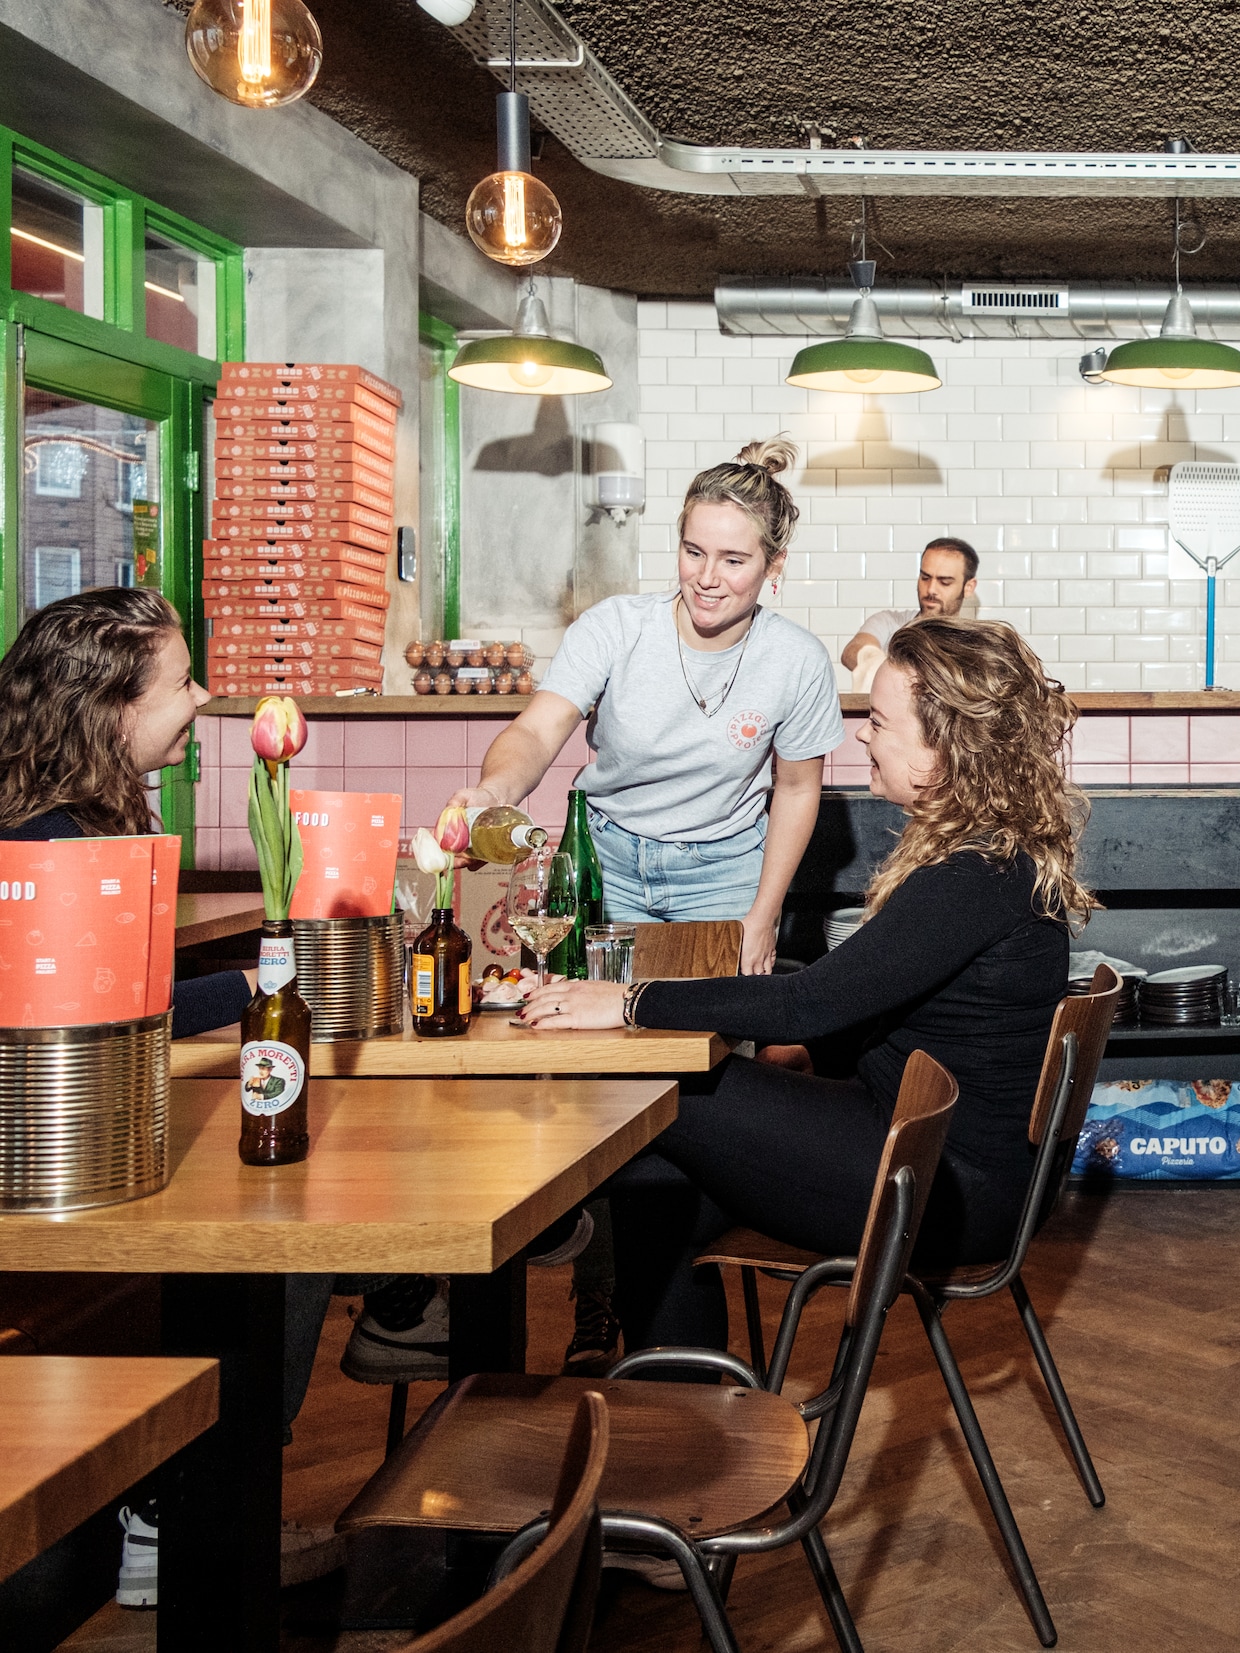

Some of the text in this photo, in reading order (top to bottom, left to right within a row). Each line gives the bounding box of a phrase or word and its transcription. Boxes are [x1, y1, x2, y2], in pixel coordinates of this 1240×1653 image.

[295, 811, 329, 827] FOOD
[0, 881, 36, 900] OOD
[260, 957, 287, 965] ZERO
[257, 1049, 298, 1082] MORETTI
[249, 1099, 280, 1109] ZERO
[1130, 1137, 1227, 1155] CAPUTO
[1161, 1156, 1195, 1166] Pizzeria
